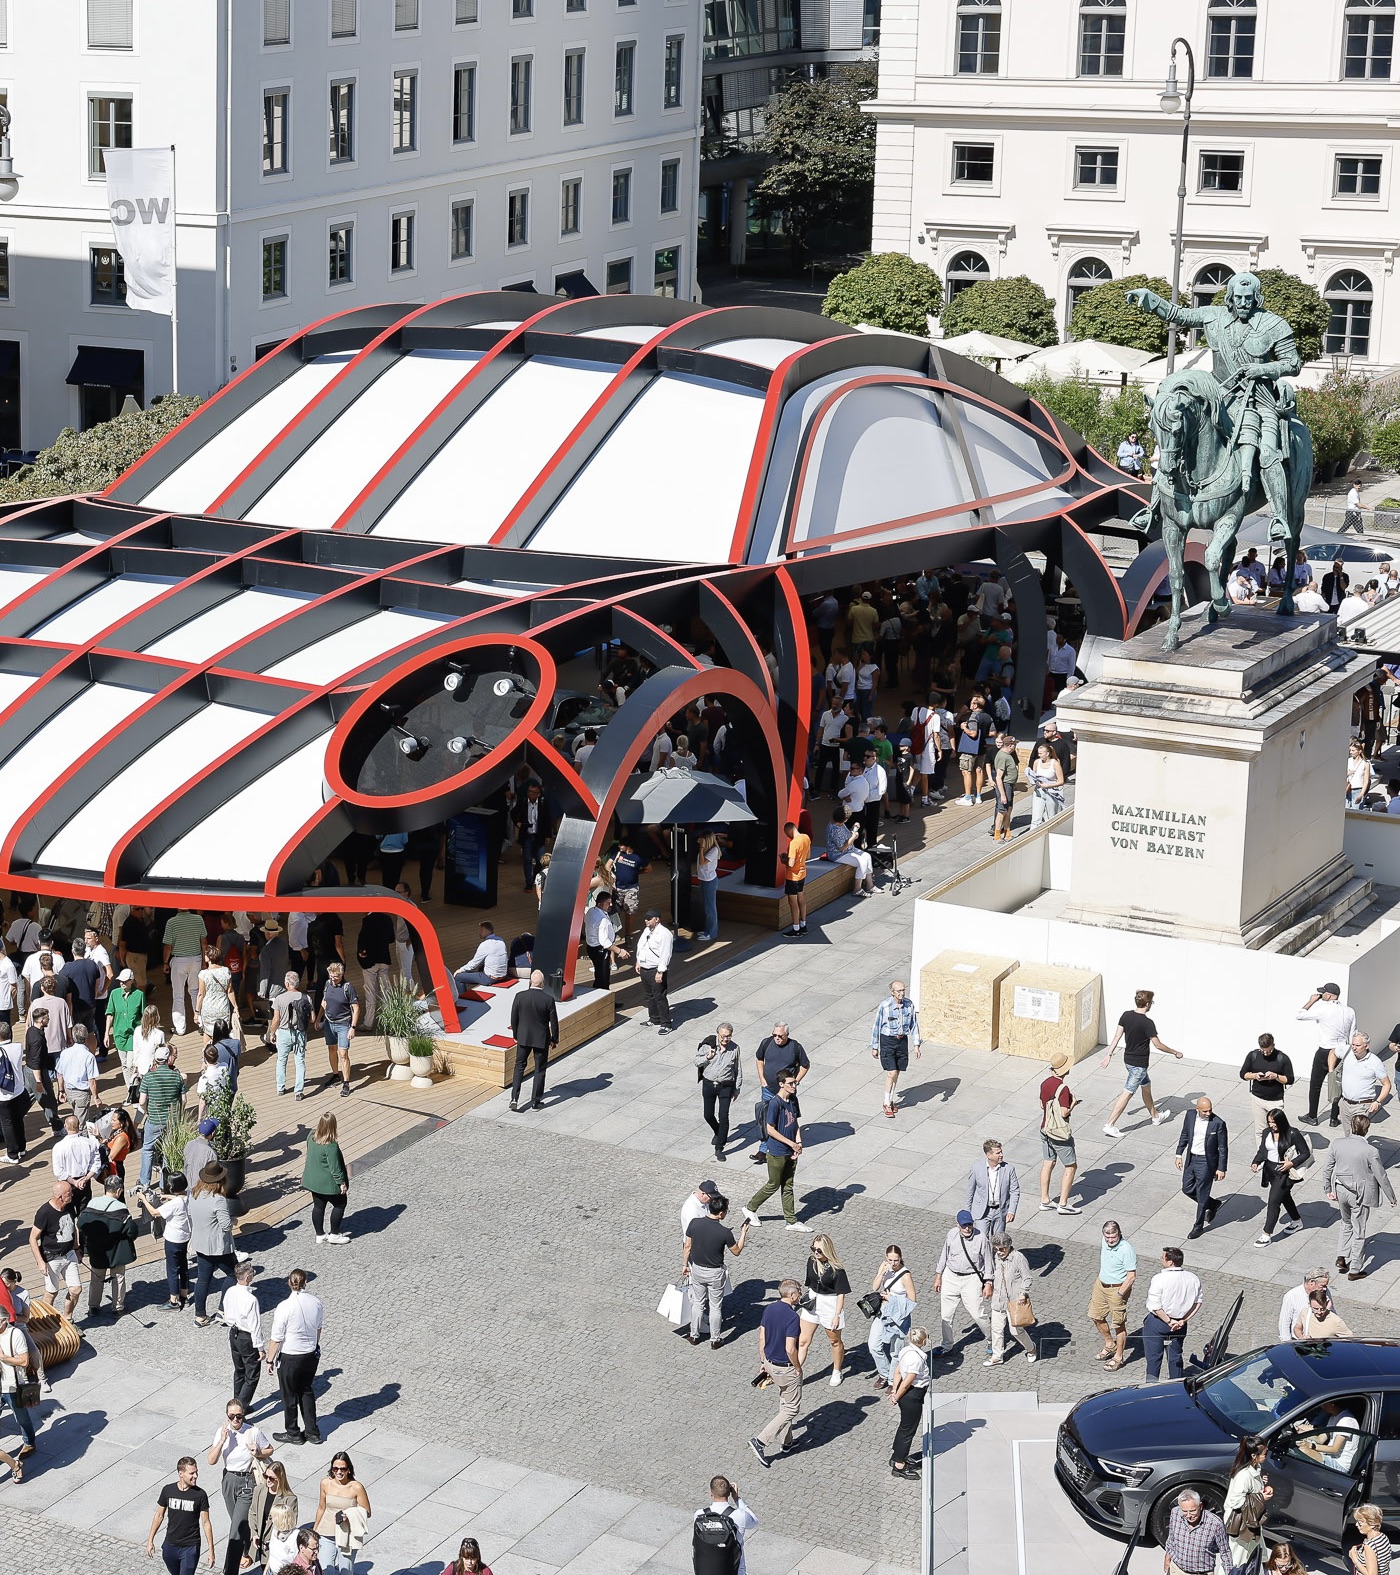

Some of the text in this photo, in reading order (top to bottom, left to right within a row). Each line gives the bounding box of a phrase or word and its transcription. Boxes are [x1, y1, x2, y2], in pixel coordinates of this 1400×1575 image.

[1112, 803, 1207, 826] MAXIMILIAN
[1111, 820, 1206, 843] CHURFUERST
[1110, 836, 1205, 860] VON BAYERN
